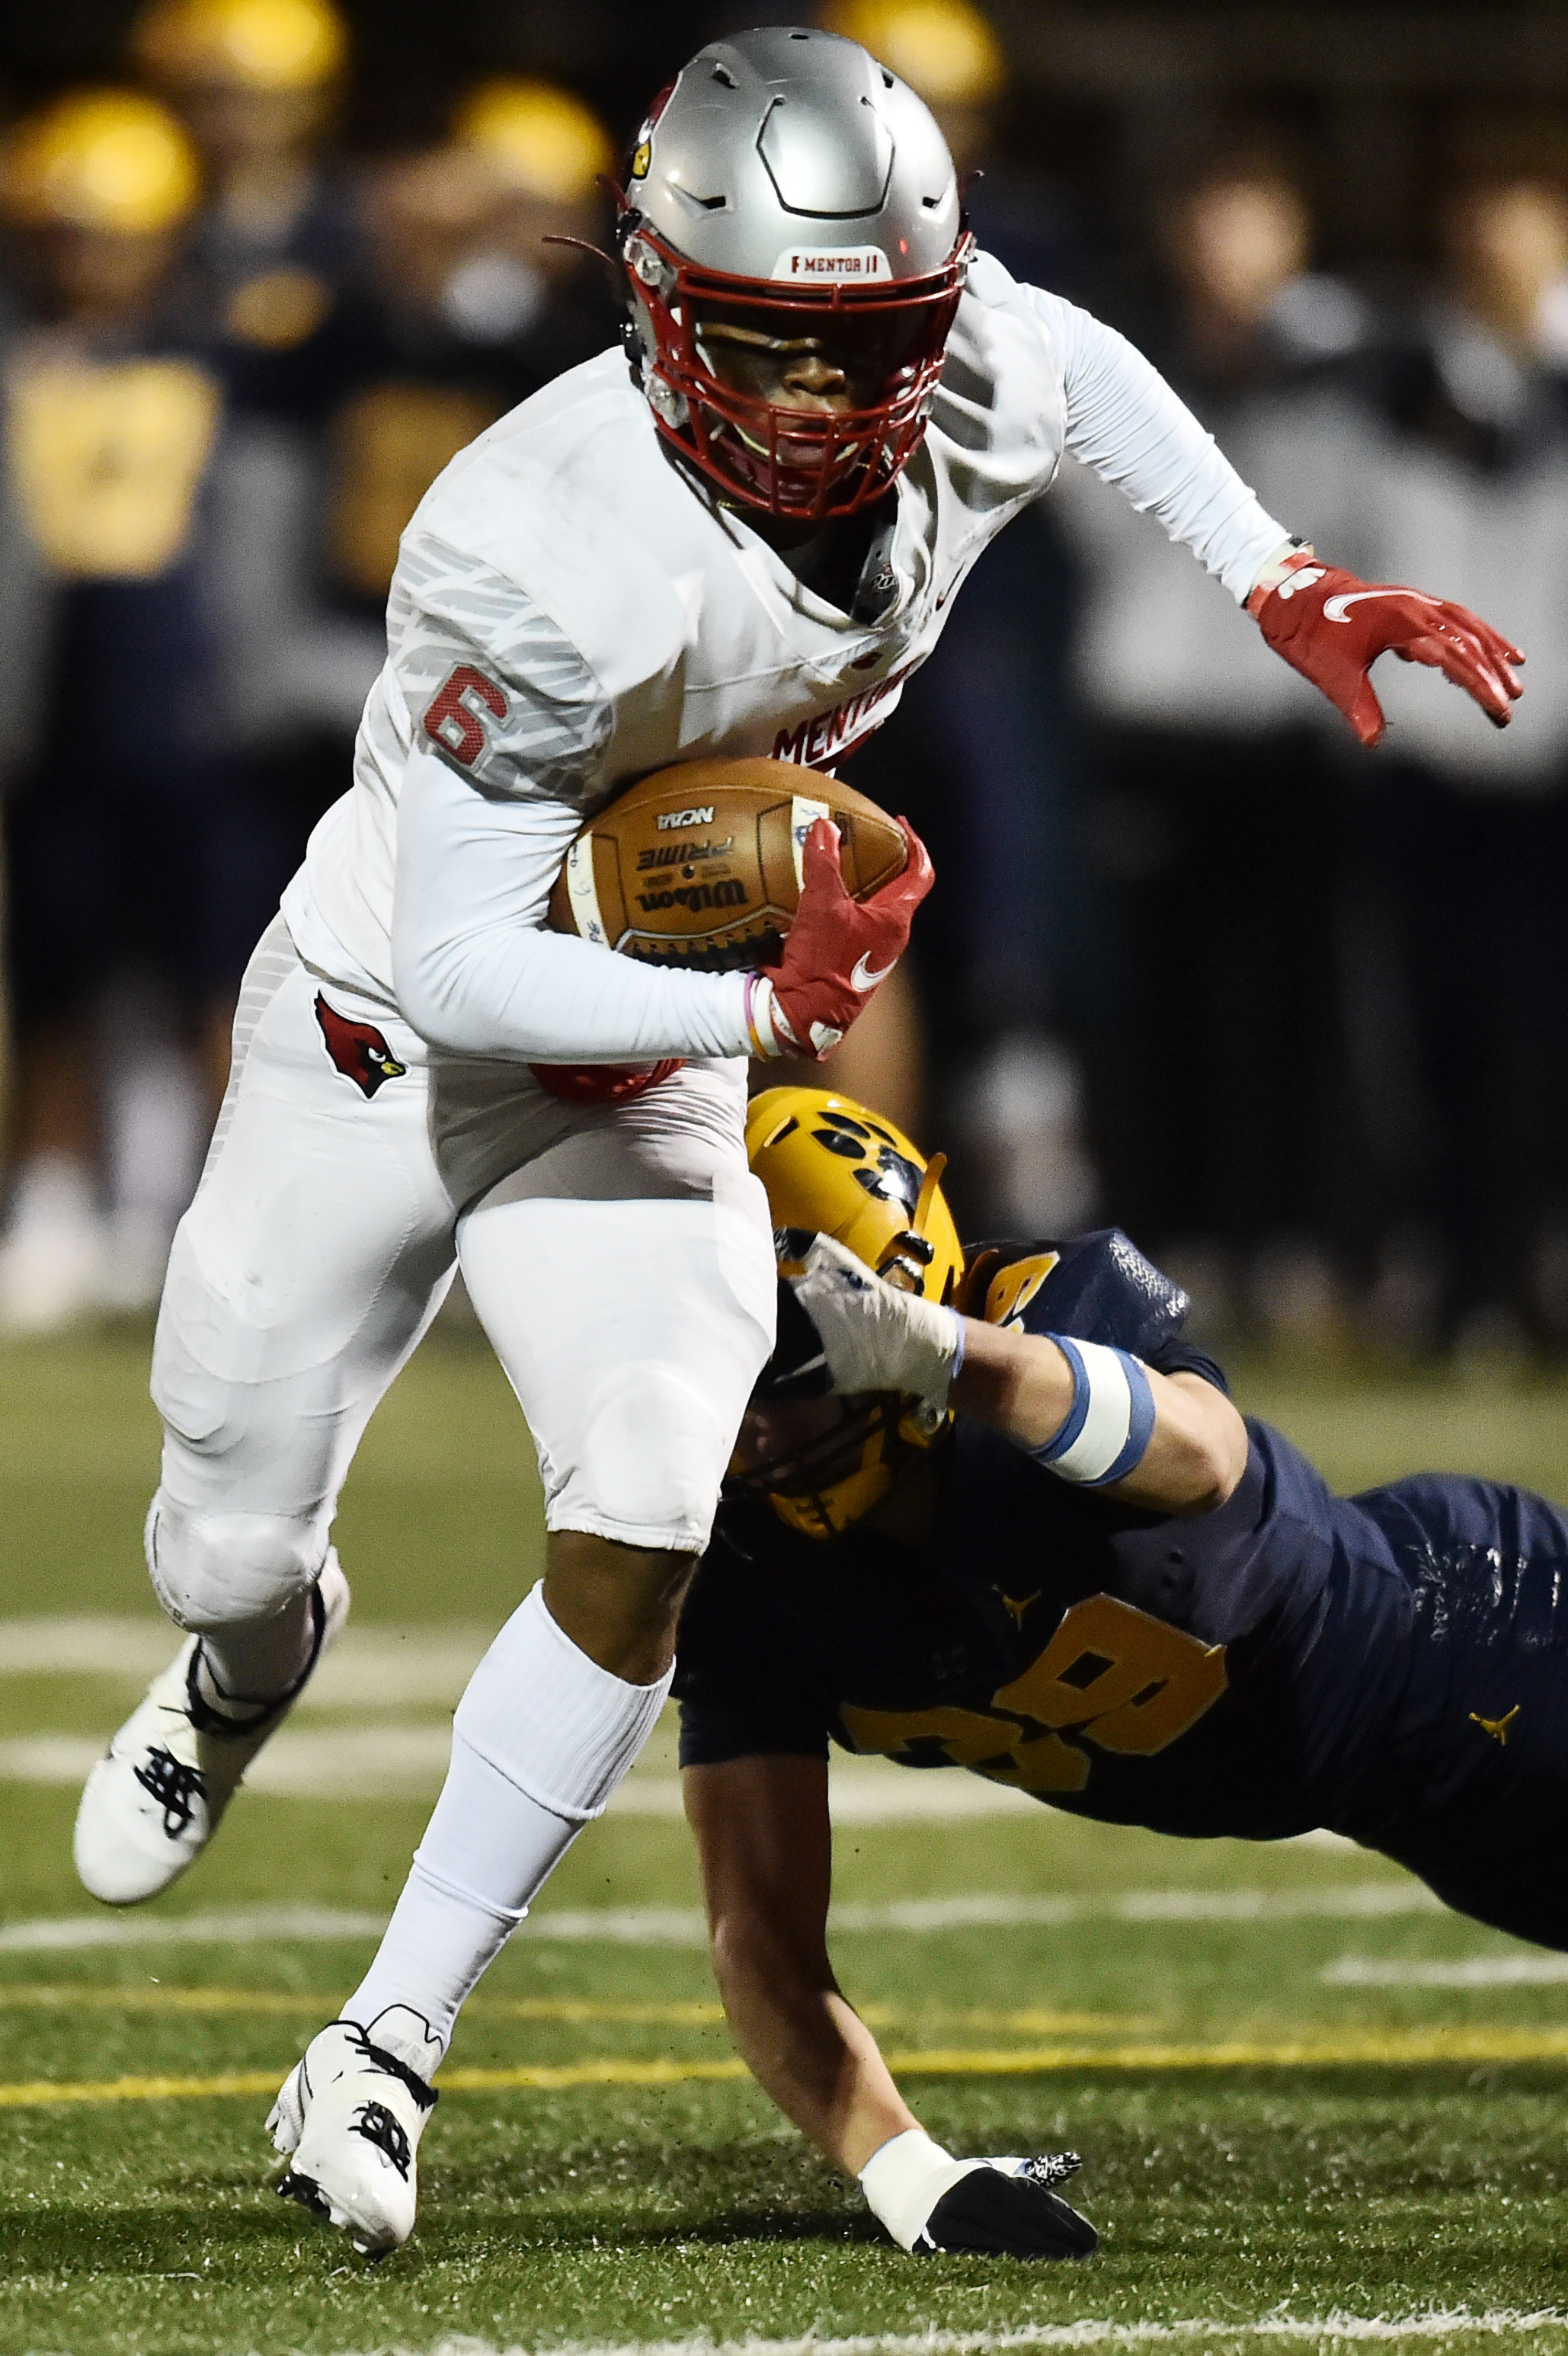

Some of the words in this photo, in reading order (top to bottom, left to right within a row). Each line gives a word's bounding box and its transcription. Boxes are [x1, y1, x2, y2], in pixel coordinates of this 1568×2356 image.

[805, 257, 862, 273] MENTOR
[423, 663, 512, 769] 6
[657, 806, 715, 831] NCAA
[636, 837, 734, 871] PRIME
[635, 879, 748, 913] Wilson
